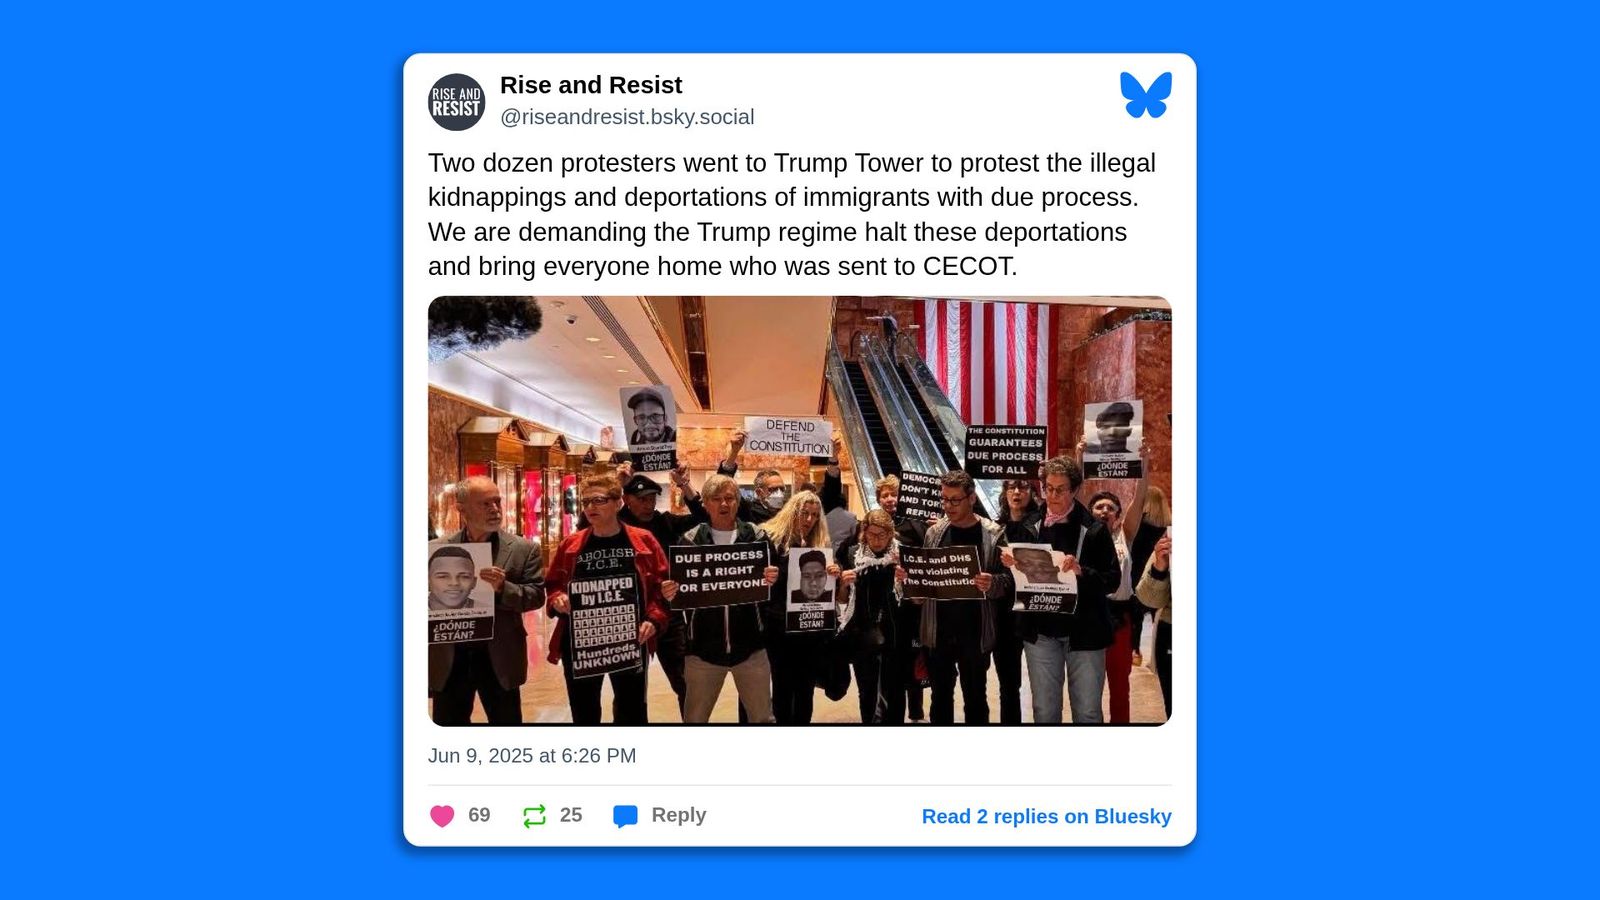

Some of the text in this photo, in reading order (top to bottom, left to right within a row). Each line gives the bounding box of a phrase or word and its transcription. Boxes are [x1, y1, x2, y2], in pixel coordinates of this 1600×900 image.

[766, 419, 815, 432] DEFEND
[781, 432, 801, 442] THE
[969, 438, 1043, 448] GUARANTEES
[750, 440, 830, 454] CONSTITUTION
[967, 451, 1043, 461] DUE PROCESS
[982, 465, 1027, 475] FOR ALL
[901, 484, 930, 495] DON'T
[899, 495, 919, 504] AND
[675, 550, 764, 564] DUE PROCESS
[928, 555, 947, 564] and
[949, 554, 972, 563] DHS
[686, 565, 754, 578] IS A RIGHT
[925, 566, 970, 576] violating
[571, 577, 633, 594] KIDNAPPED
[581, 589, 625, 606] by I.C.E.
[433, 620, 476, 633] ¿DÓNDE
[434, 629, 474, 641] ESTÁN?
[577, 643, 636, 660] Hundreds
[573, 649, 640, 670] UNKNOWN
